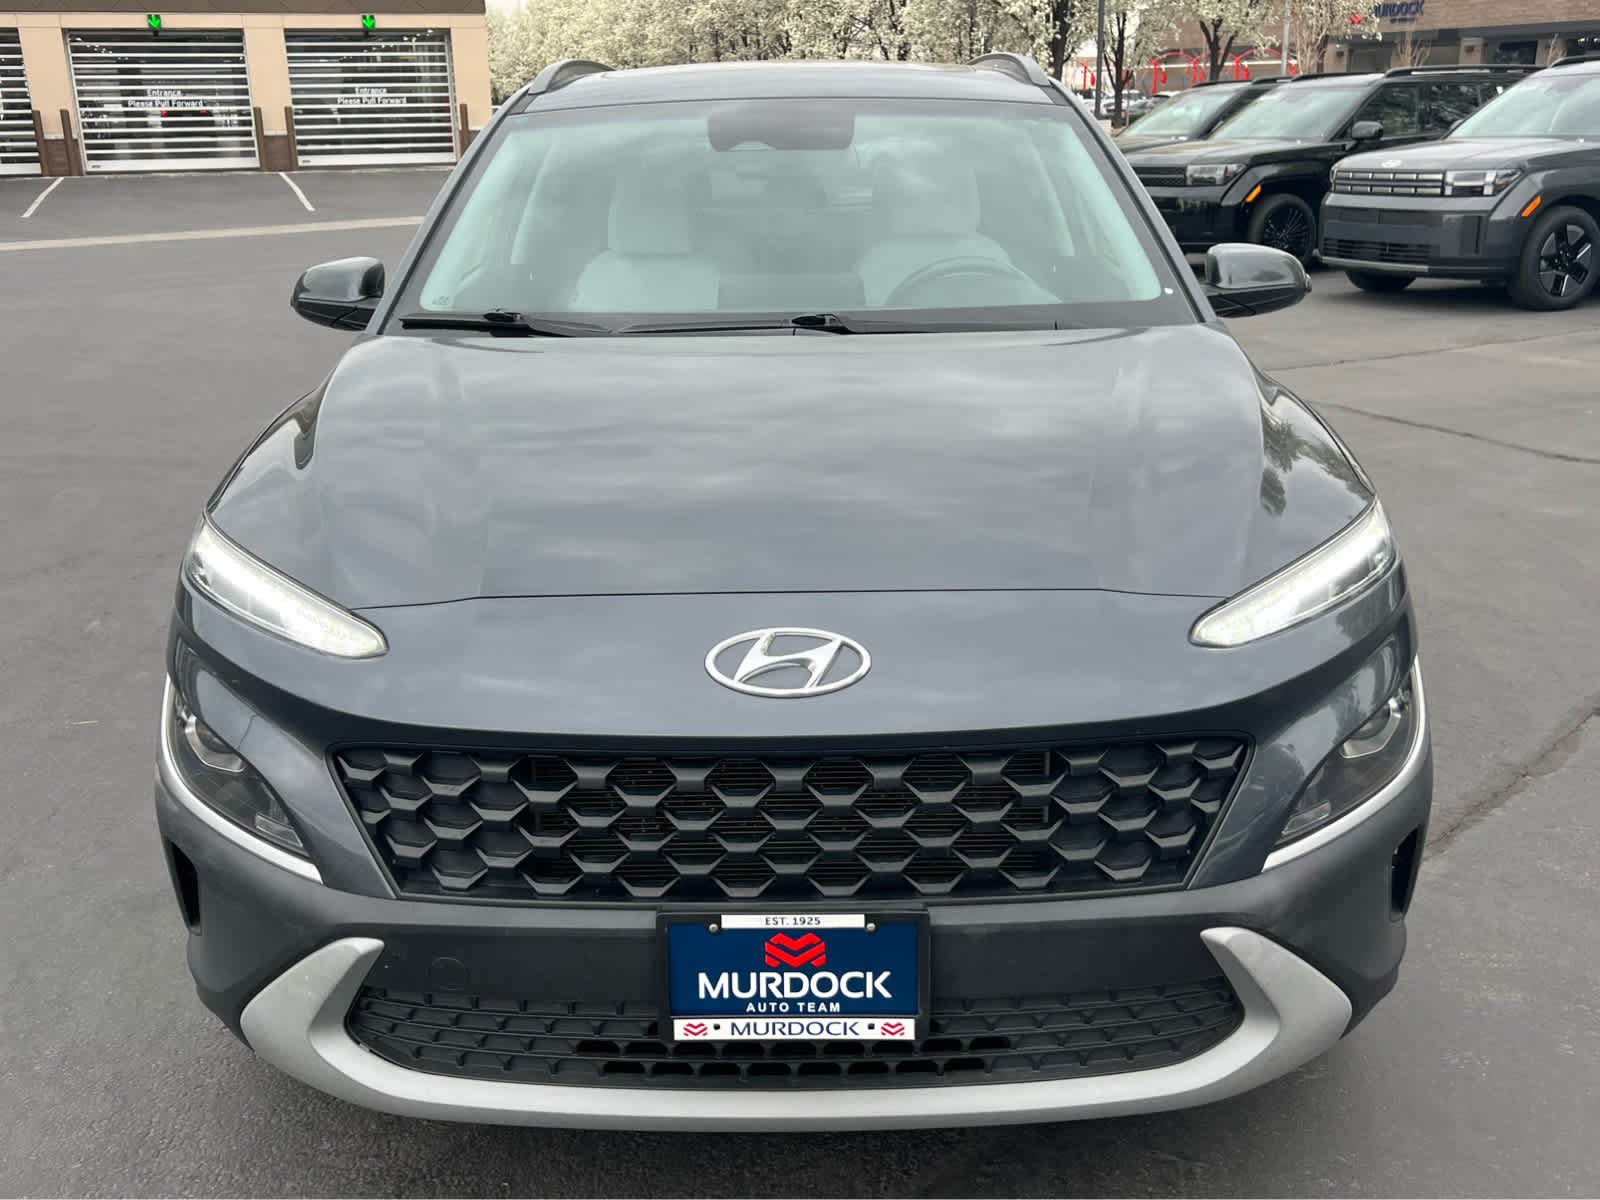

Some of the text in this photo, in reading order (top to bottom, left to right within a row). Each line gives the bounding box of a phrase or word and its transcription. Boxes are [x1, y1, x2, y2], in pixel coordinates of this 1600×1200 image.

[147, 88, 181, 98] Entrance
[355, 87, 387, 96] Entrance
[128, 98, 203, 108] Please Pull Forward
[337, 96, 407, 105] Please Pull Forward
[765, 916, 821, 926] EST. 1925
[698, 971, 892, 999] MURDOCK
[746, 1002, 841, 1012] AUTO TEAM
[731, 1021, 860, 1036] MURDOCK
